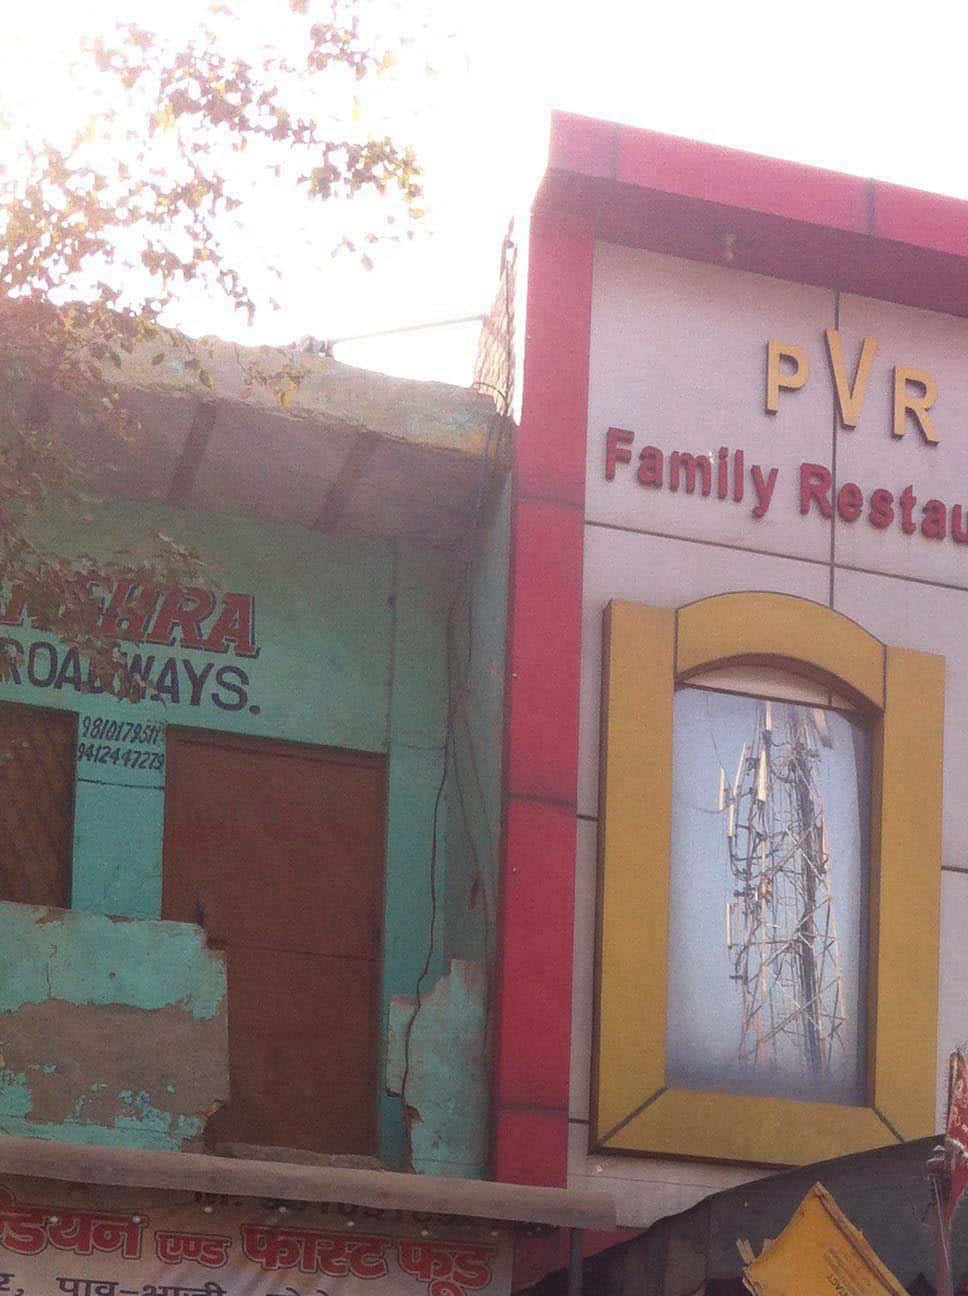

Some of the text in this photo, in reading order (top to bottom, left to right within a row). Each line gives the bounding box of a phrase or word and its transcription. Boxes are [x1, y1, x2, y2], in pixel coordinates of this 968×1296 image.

[765, 329, 940, 445] PVR
[604, 427, 779, 518] Family
[242, 1223, 393, 1280] फास्ट
